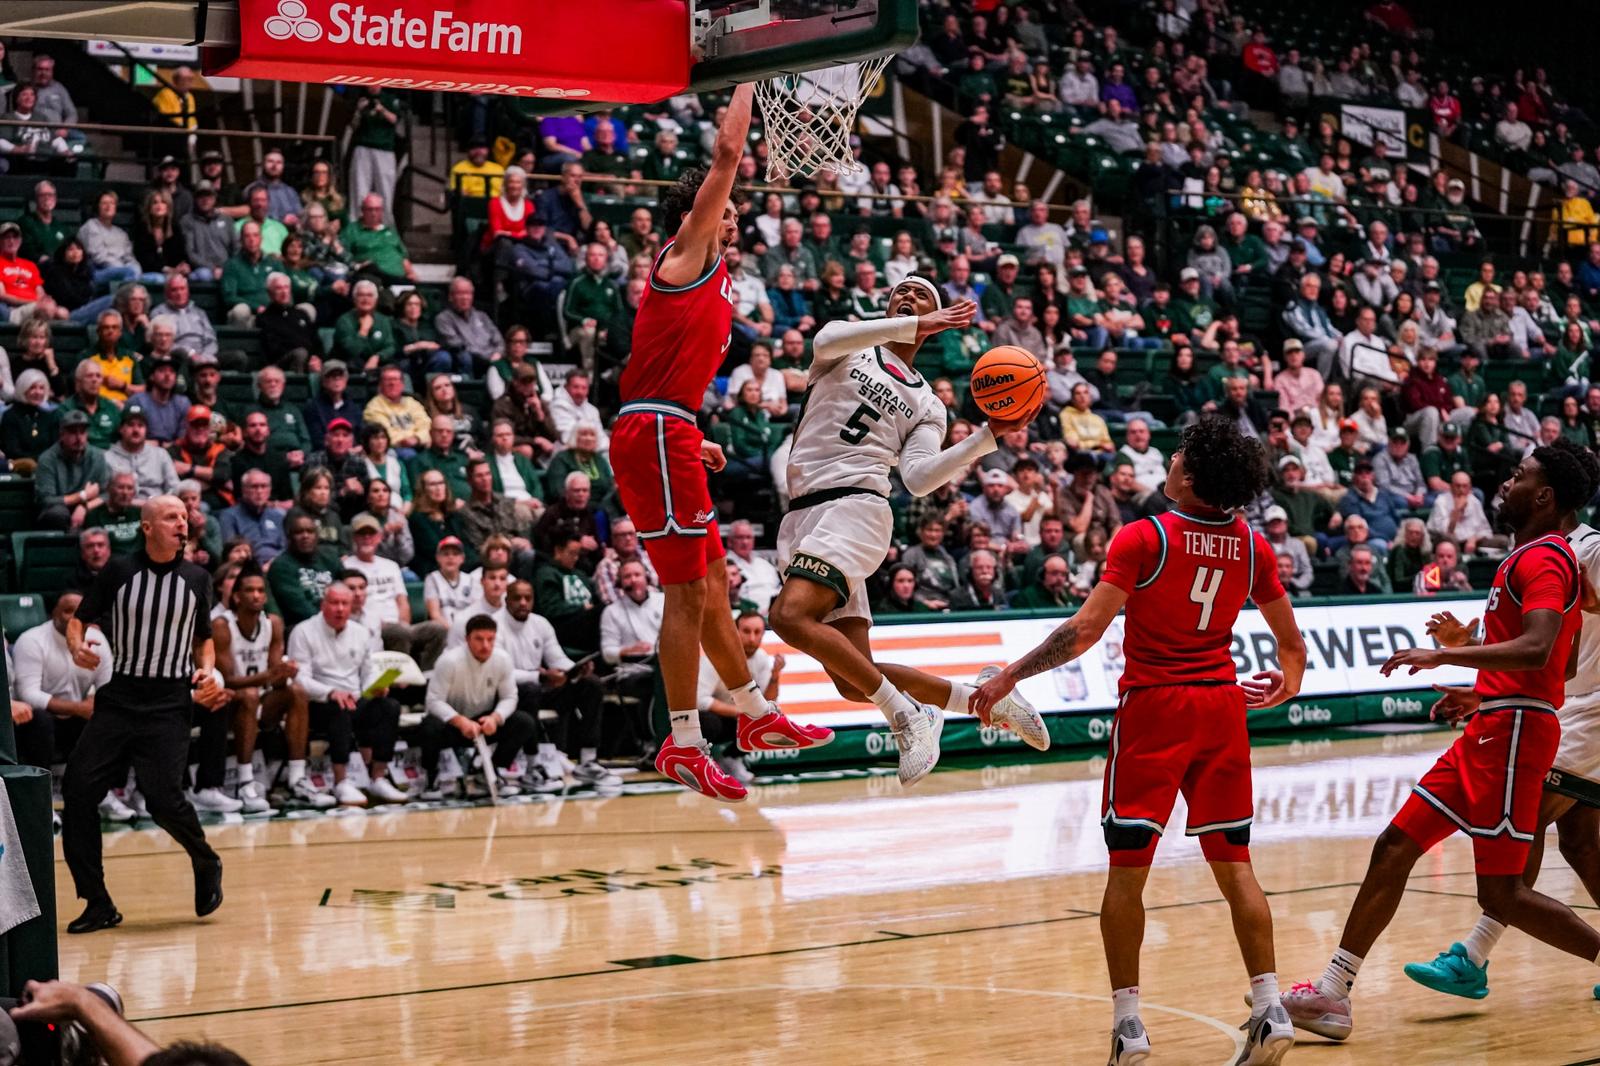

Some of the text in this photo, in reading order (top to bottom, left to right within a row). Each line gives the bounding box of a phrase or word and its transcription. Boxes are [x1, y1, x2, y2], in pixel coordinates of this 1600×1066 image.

[850, 368, 914, 419] COLORADO
[858, 385, 897, 416] STATE
[972, 374, 1015, 392] Wilson
[984, 396, 1015, 411] NCAA
[839, 403, 881, 445] 5
[1183, 531, 1241, 561] TENETTE
[1190, 566, 1224, 631] 4
[1231, 625, 1417, 674] BRWED
